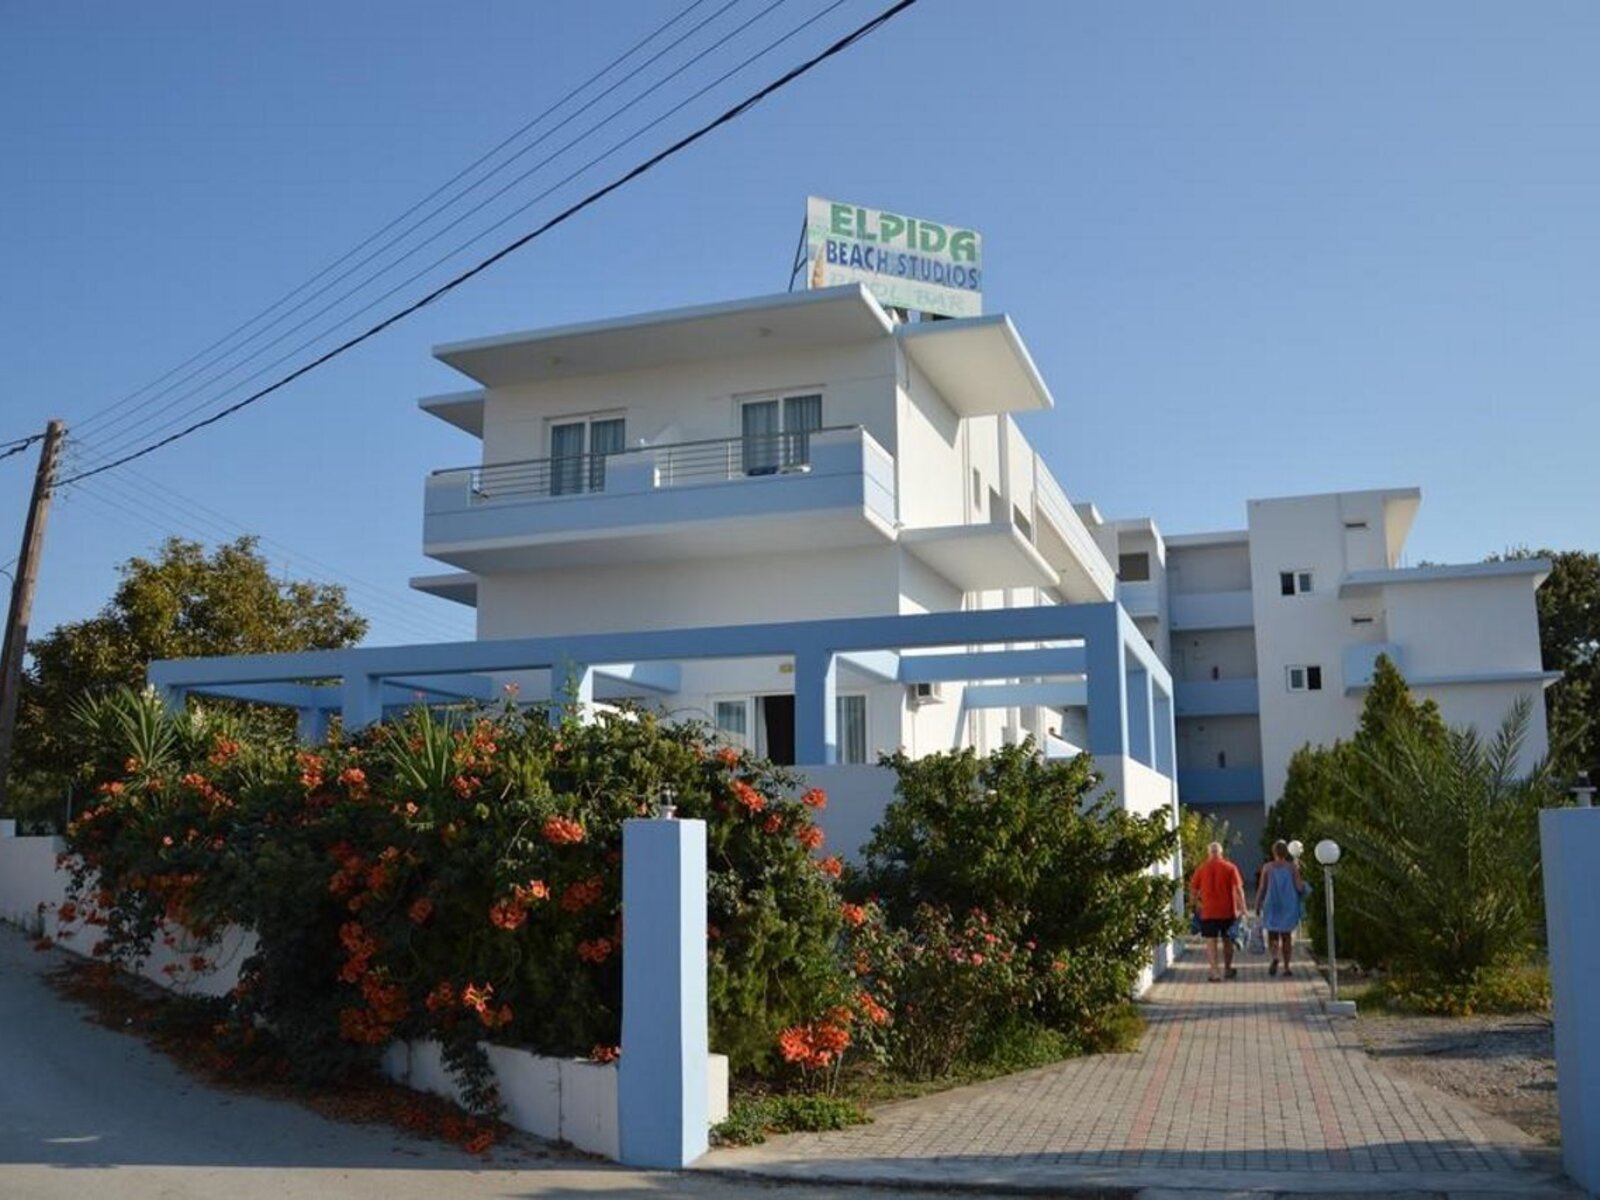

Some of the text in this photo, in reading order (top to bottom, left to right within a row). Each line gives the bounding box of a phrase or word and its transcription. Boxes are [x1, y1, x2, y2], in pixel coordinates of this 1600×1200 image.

[831, 203, 976, 262] ELPIDA
[826, 239, 978, 290] BEACH STUDIOS
